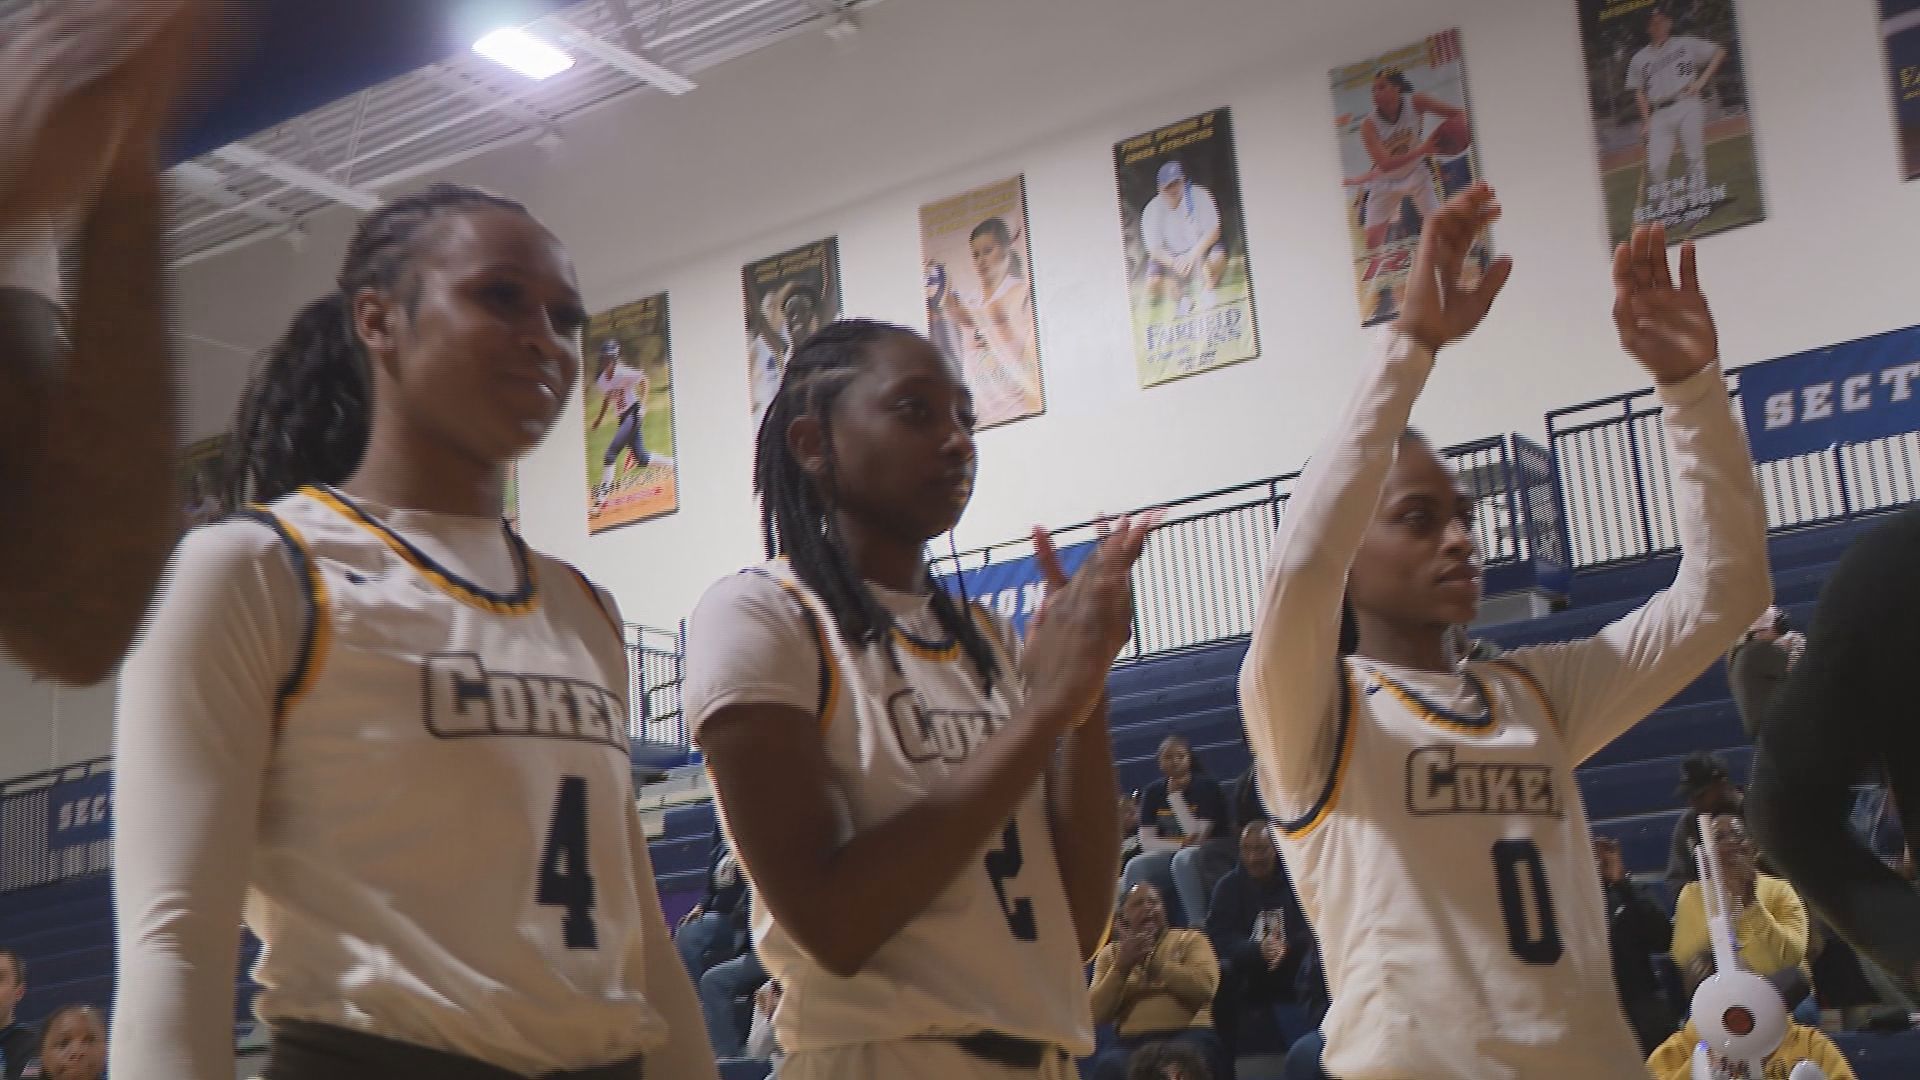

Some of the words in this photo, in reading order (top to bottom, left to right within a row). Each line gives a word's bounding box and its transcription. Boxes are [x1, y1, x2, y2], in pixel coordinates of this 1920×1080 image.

[1632, 183, 1729, 222] BLANTON
[538, 777, 598, 951] 4
[983, 814, 1038, 942] 2
[1490, 837, 1565, 966] 0
